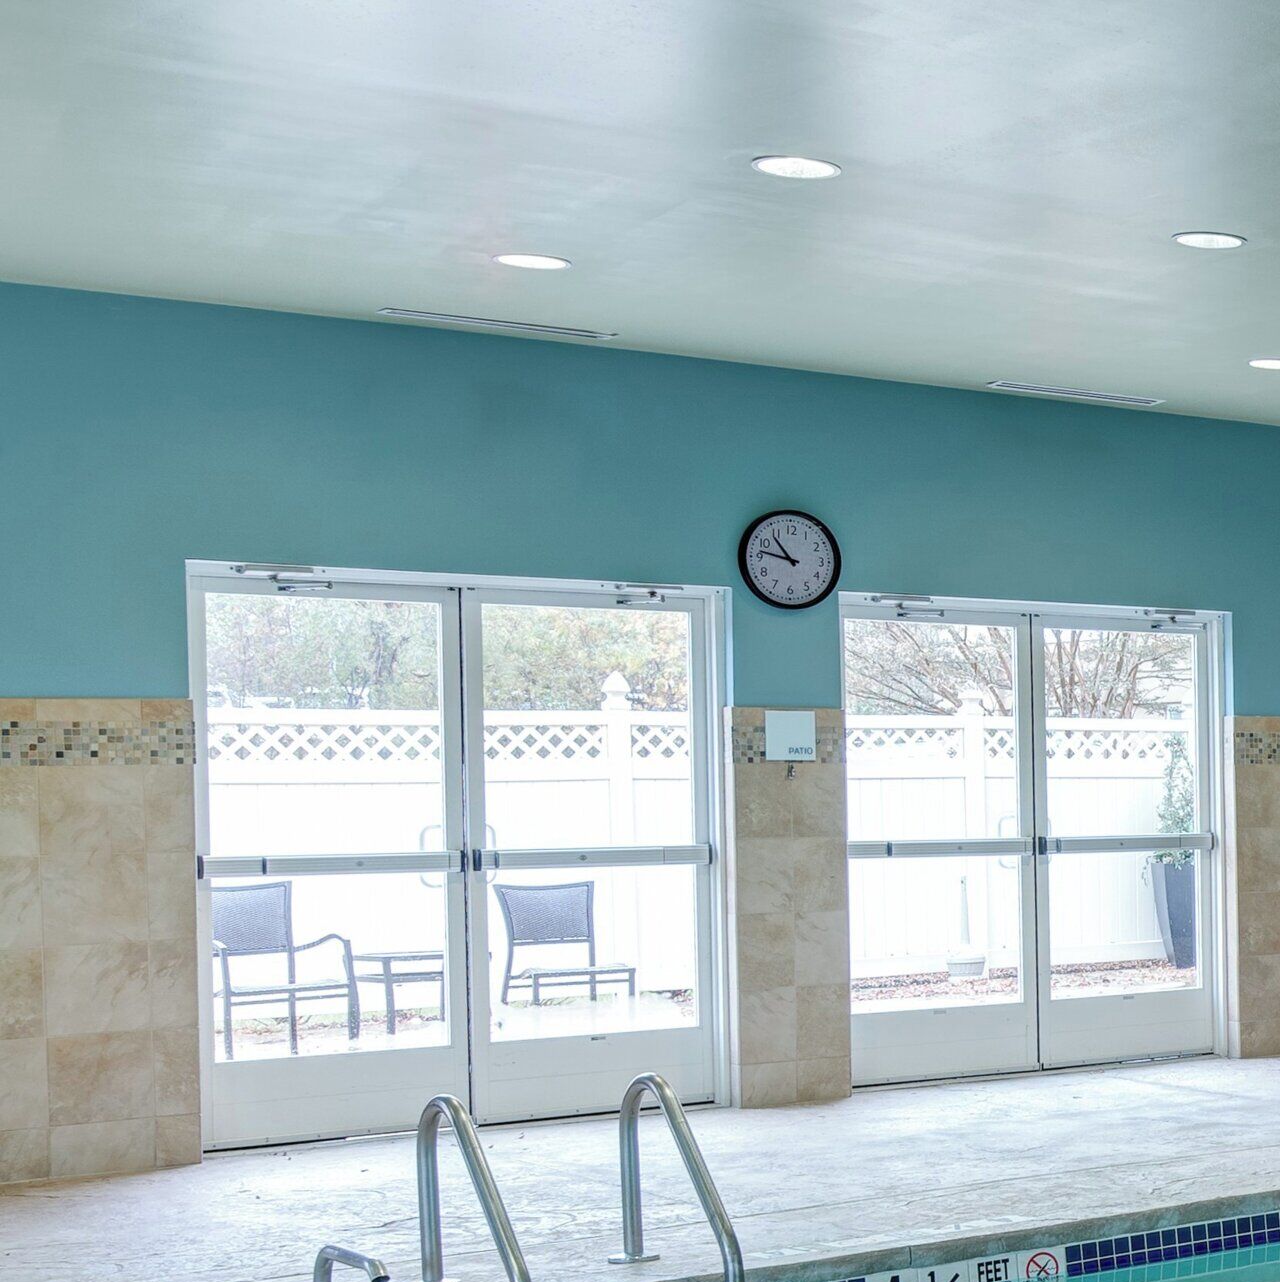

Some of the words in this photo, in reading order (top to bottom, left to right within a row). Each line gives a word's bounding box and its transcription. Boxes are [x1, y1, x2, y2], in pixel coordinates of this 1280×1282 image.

[772, 529, 780, 538] 11
[787, 525, 797, 536] 12
[760, 538, 770, 548] 10
[814, 542, 820, 552] 2
[756, 552, 763, 562] 9
[819, 557, 824, 567] 3
[761, 567, 767, 577] 8
[814, 572, 819, 580] 4
[772, 580, 778, 589] 7
[803, 582, 809, 591] 5
[787, 586, 793, 595] 6
